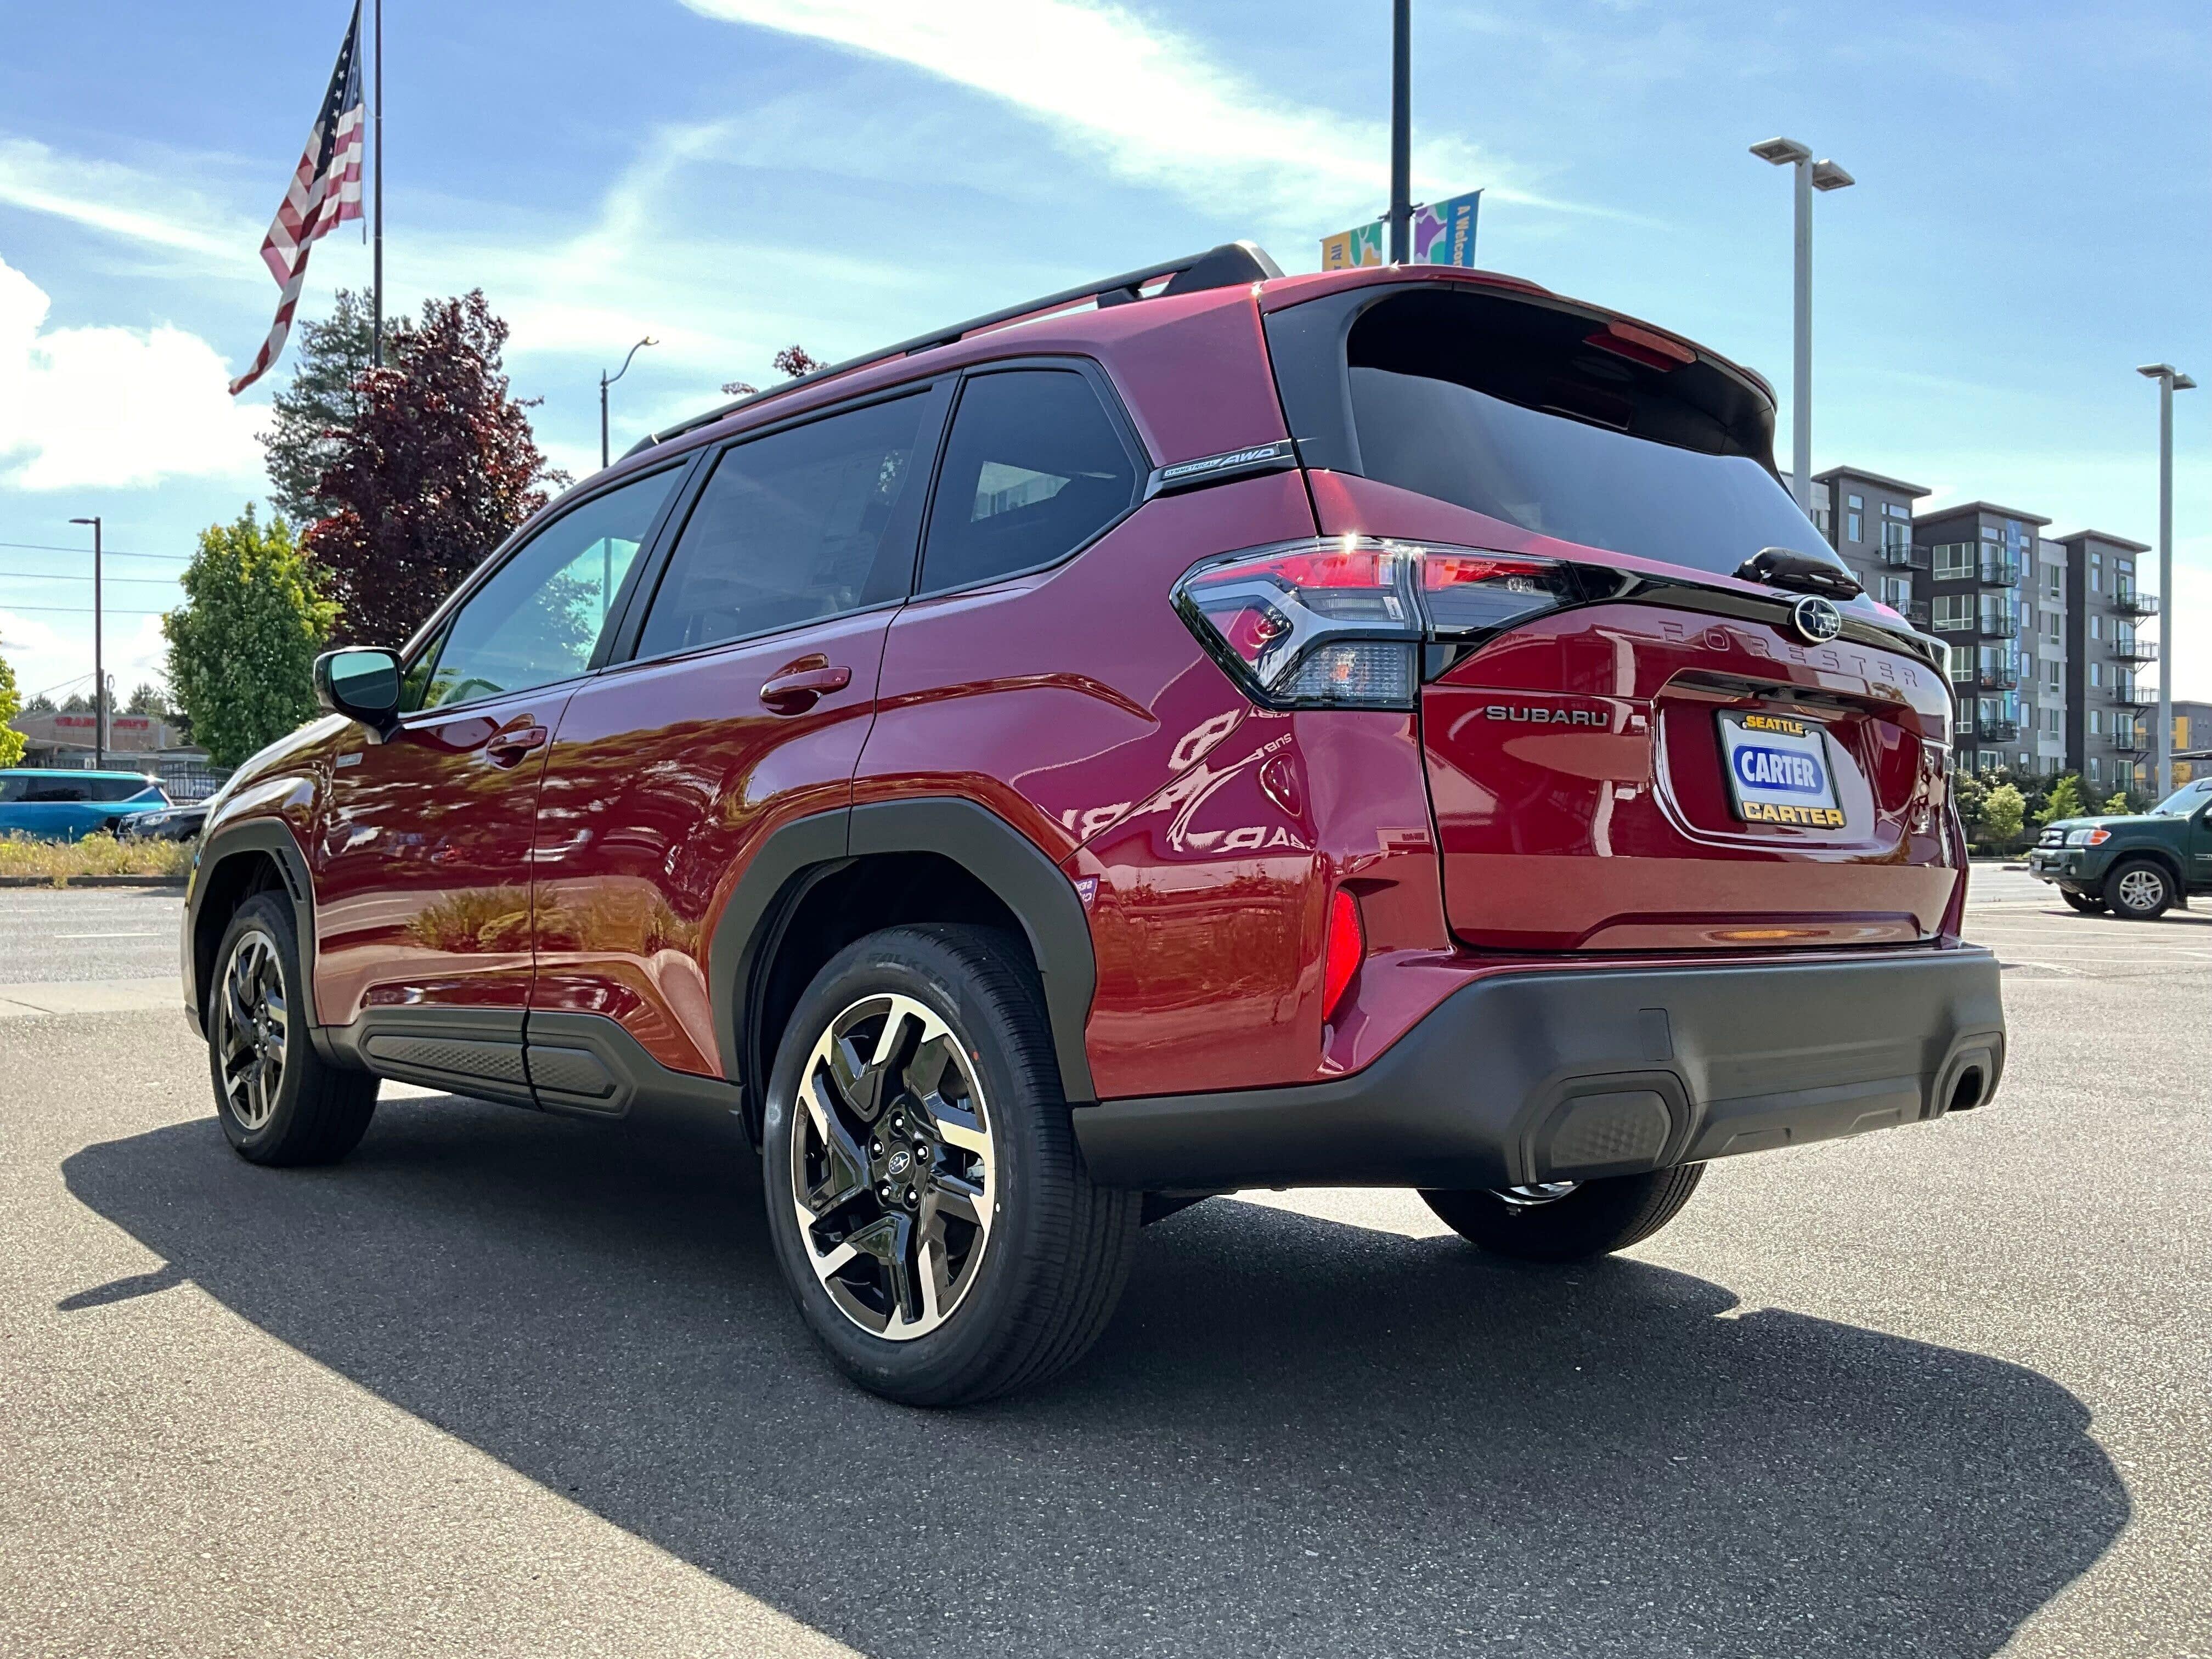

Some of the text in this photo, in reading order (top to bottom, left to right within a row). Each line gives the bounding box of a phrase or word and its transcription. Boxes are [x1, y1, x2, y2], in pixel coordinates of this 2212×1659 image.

[1457, 205, 1471, 216] A
[1164, 448, 1276, 476] SYMMETRICAL AWD
[1657, 620, 1919, 687] FORESTER
[1486, 706, 1608, 727] SUBARU
[1746, 715, 1804, 735] SEATTLE
[1741, 751, 1816, 788] CARTER
[1742, 801, 1844, 826] CARTER
